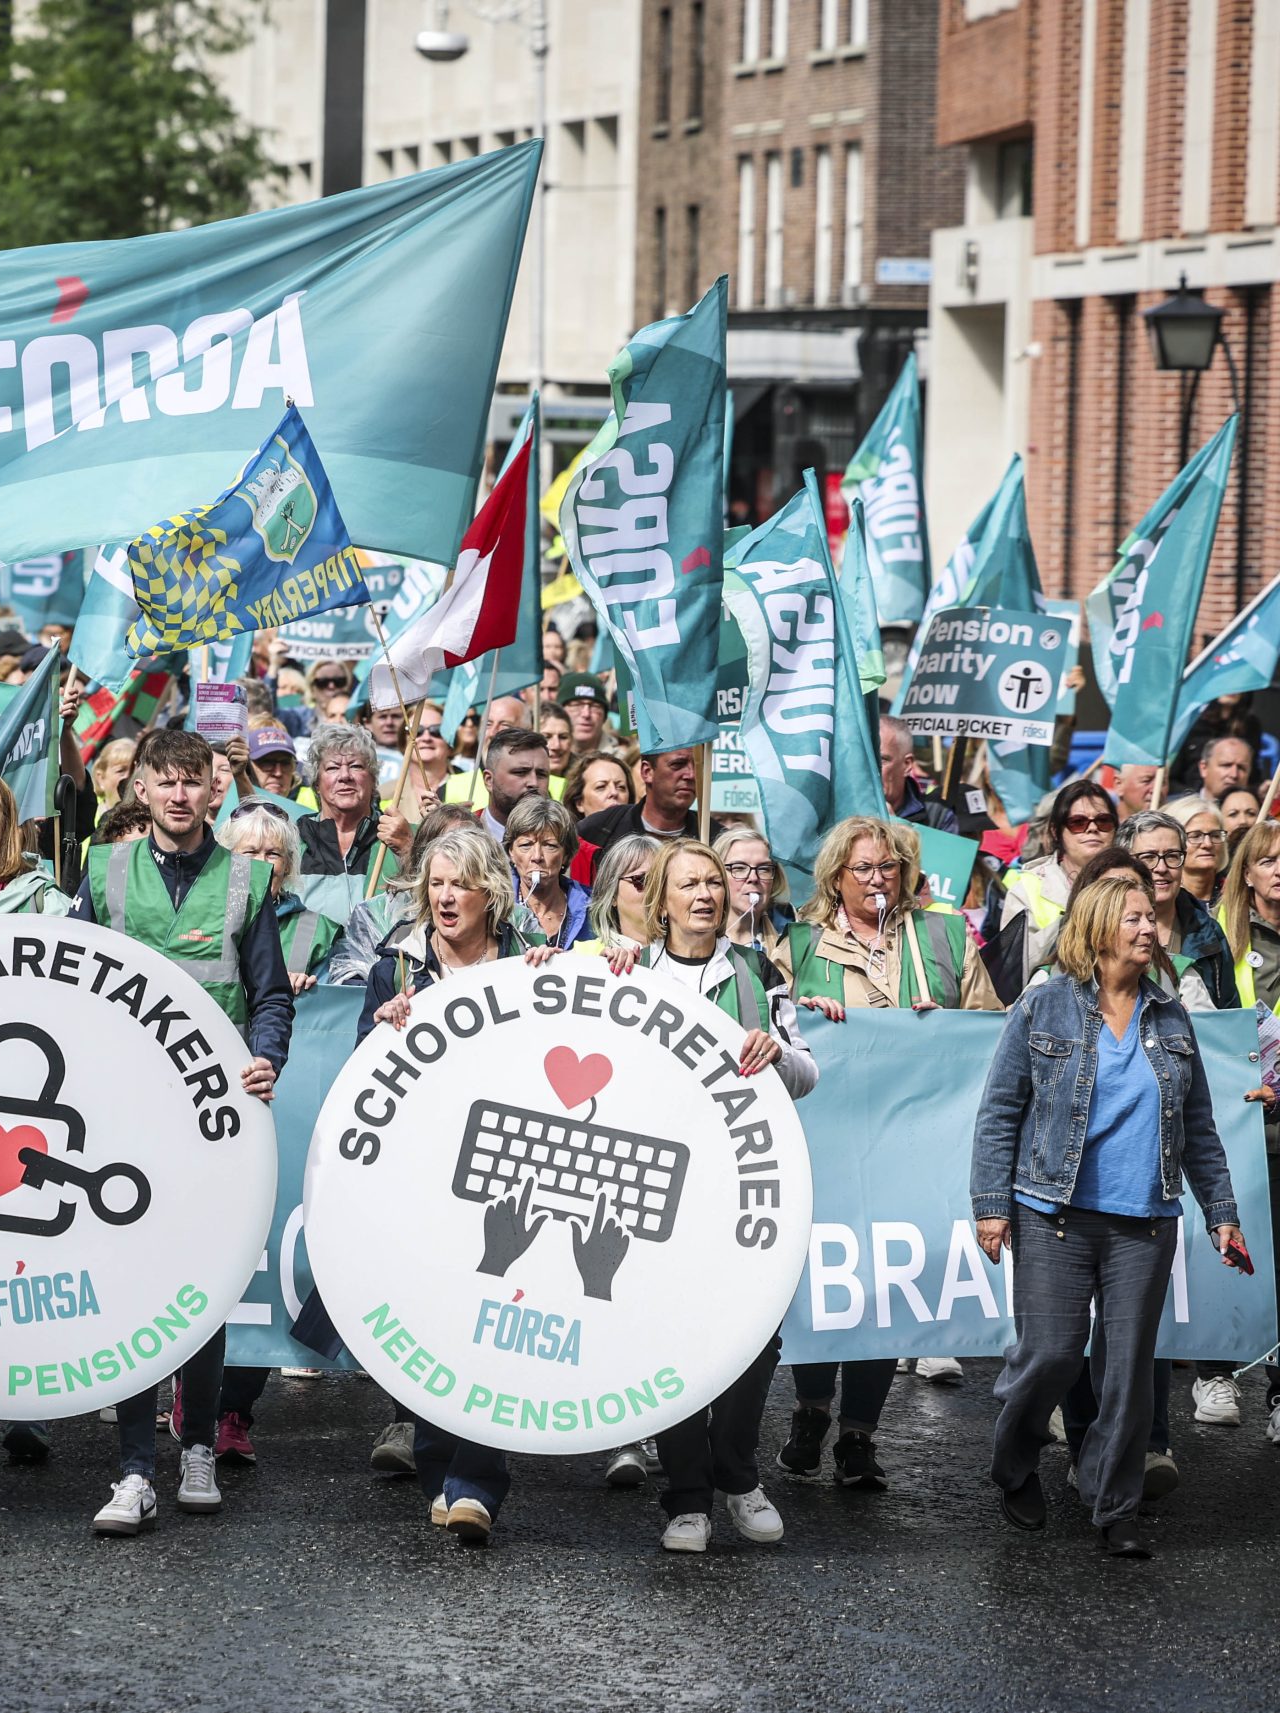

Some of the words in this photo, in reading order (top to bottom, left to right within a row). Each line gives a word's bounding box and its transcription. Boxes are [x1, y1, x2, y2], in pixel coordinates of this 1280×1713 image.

[913, 644, 996, 681] parity
[925, 612, 1033, 647] Pension
[905, 683, 960, 706] now
[338, 984, 520, 1166] SCHOOL
[532, 974, 781, 1252] SECRETARIES
[8, 1283, 209, 1396] PENSIONS
[472, 1288, 582, 1367] FÓRSA
[361, 1302, 458, 1398] NEED
[462, 1366, 687, 1433] PENSIONS
